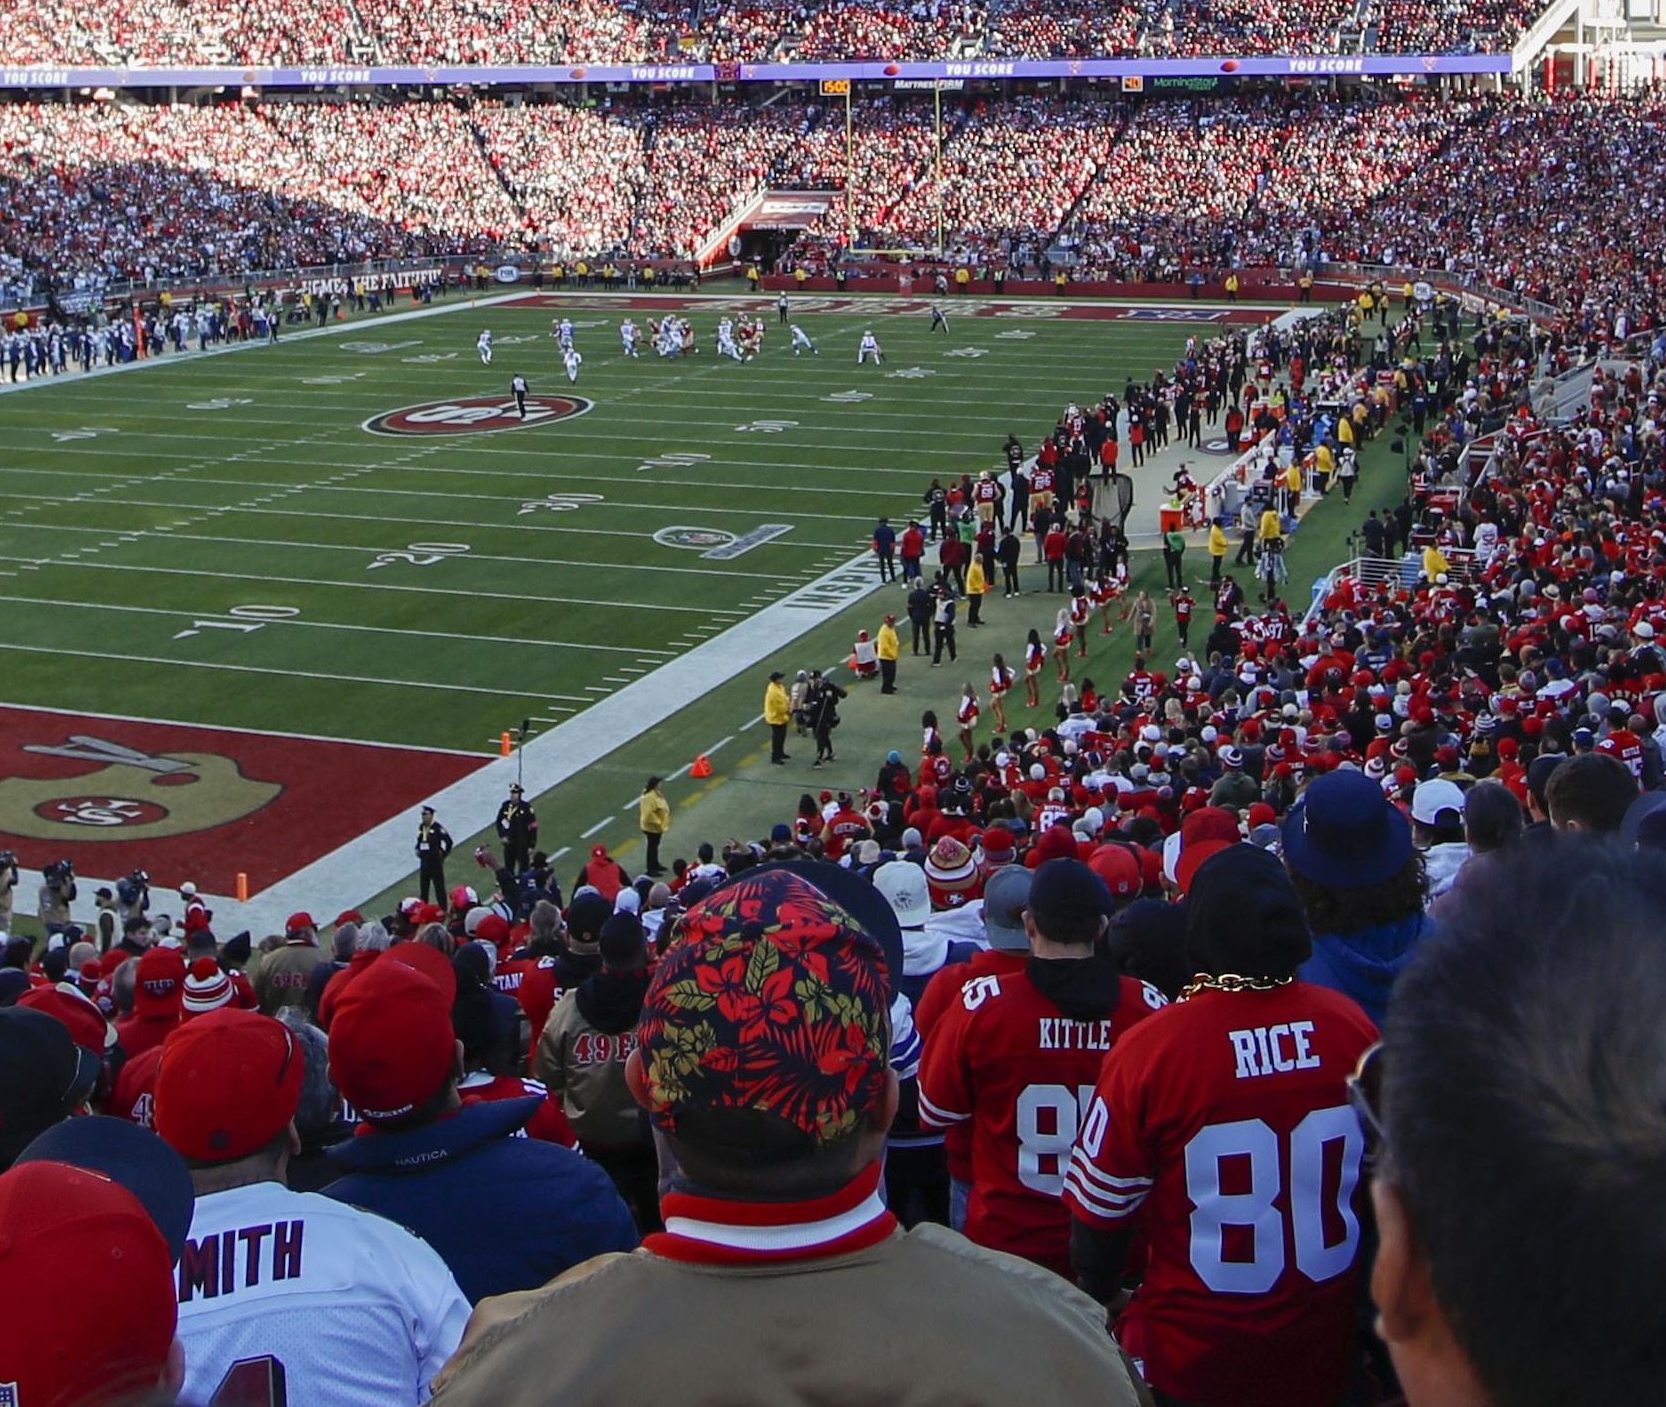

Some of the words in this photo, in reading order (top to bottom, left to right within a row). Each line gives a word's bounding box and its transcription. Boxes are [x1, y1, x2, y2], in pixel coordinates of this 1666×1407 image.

[631, 67, 657, 80] YOU
[658, 66, 695, 80] SCORE
[945, 63, 972, 76] YOU
[973, 62, 1014, 75] SCORE
[1289, 59, 1318, 73] YOU
[1319, 58, 1364, 72] SCORE
[4, 72, 29, 85] YOU
[30, 72, 68, 85] SCORE
[300, 70, 327, 83] YOU
[329, 70, 371, 83] SCORE
[397, 542, 471, 566] 20
[193, 604, 300, 635] 10
[1039, 1017, 1111, 1051] KITTLE
[1229, 1021, 1320, 1079] RICE
[395, 1148, 448, 1167] NAUTICA
[1184, 1104, 1364, 1293] 80
[177, 1219, 304, 1300] MITH
